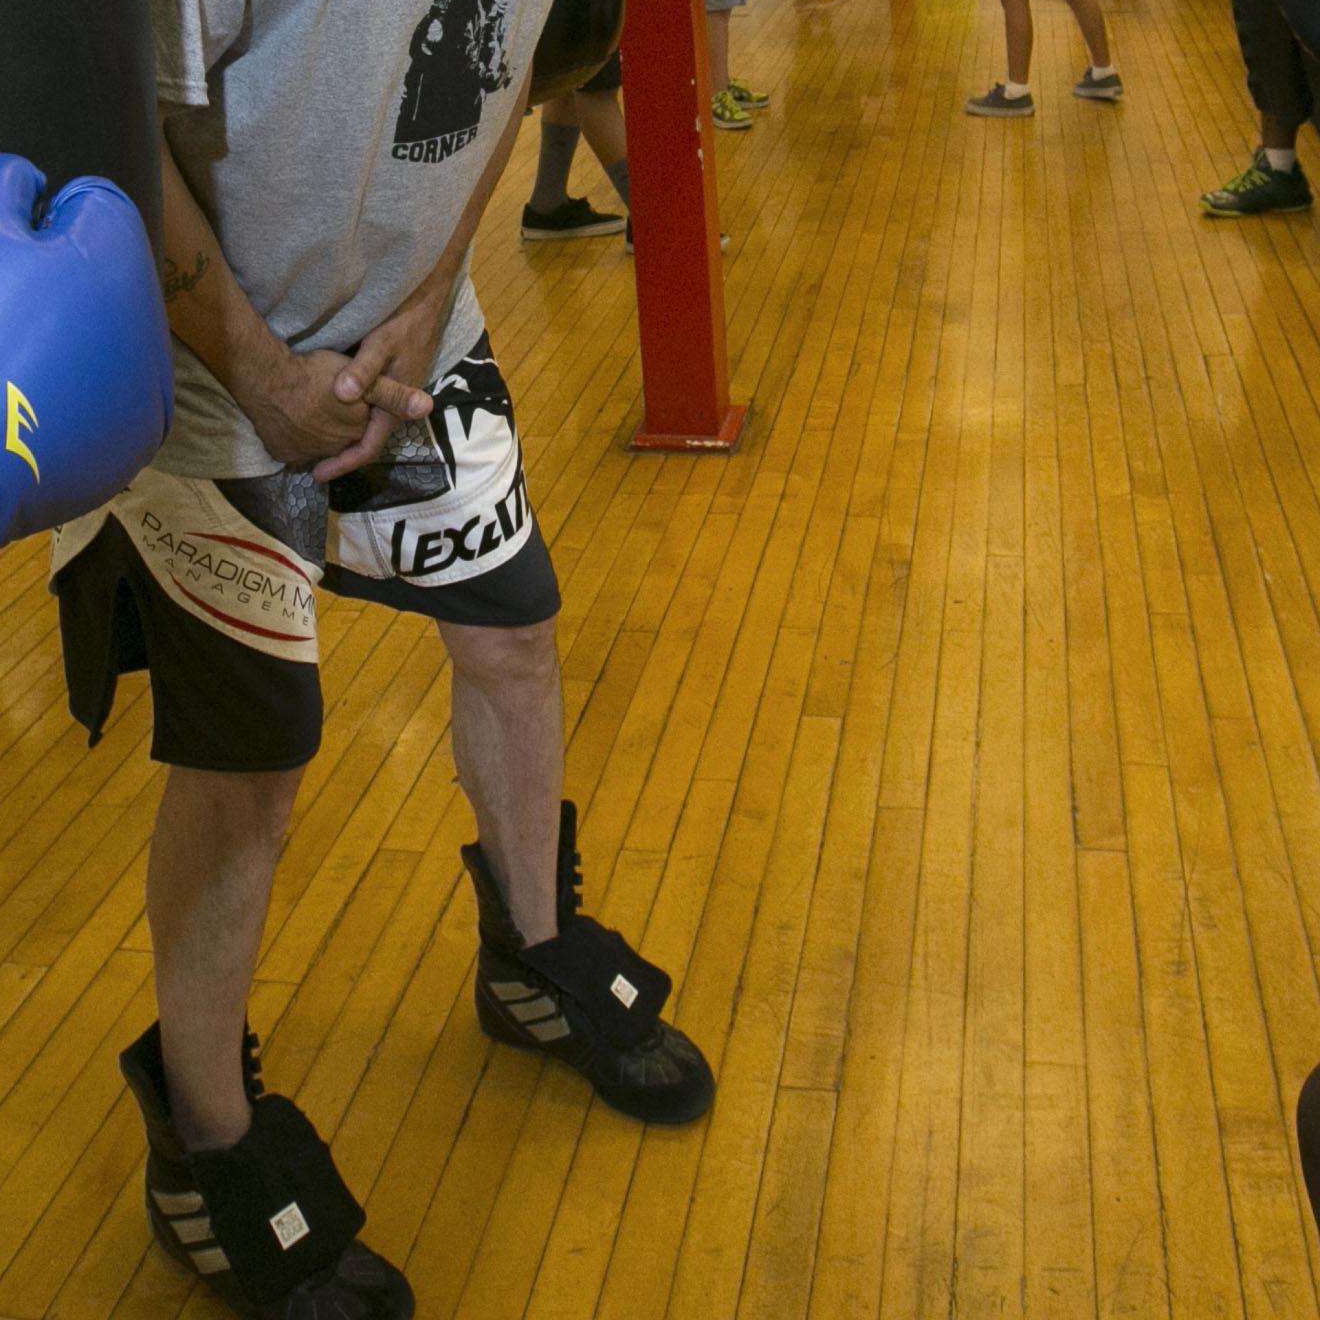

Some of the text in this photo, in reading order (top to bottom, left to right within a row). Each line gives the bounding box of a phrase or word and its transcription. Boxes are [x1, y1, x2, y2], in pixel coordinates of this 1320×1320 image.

[391, 126, 479, 164] CORNER
[141, 512, 315, 617] PARADIGM M
[142, 535, 311, 627] MANAGEME
